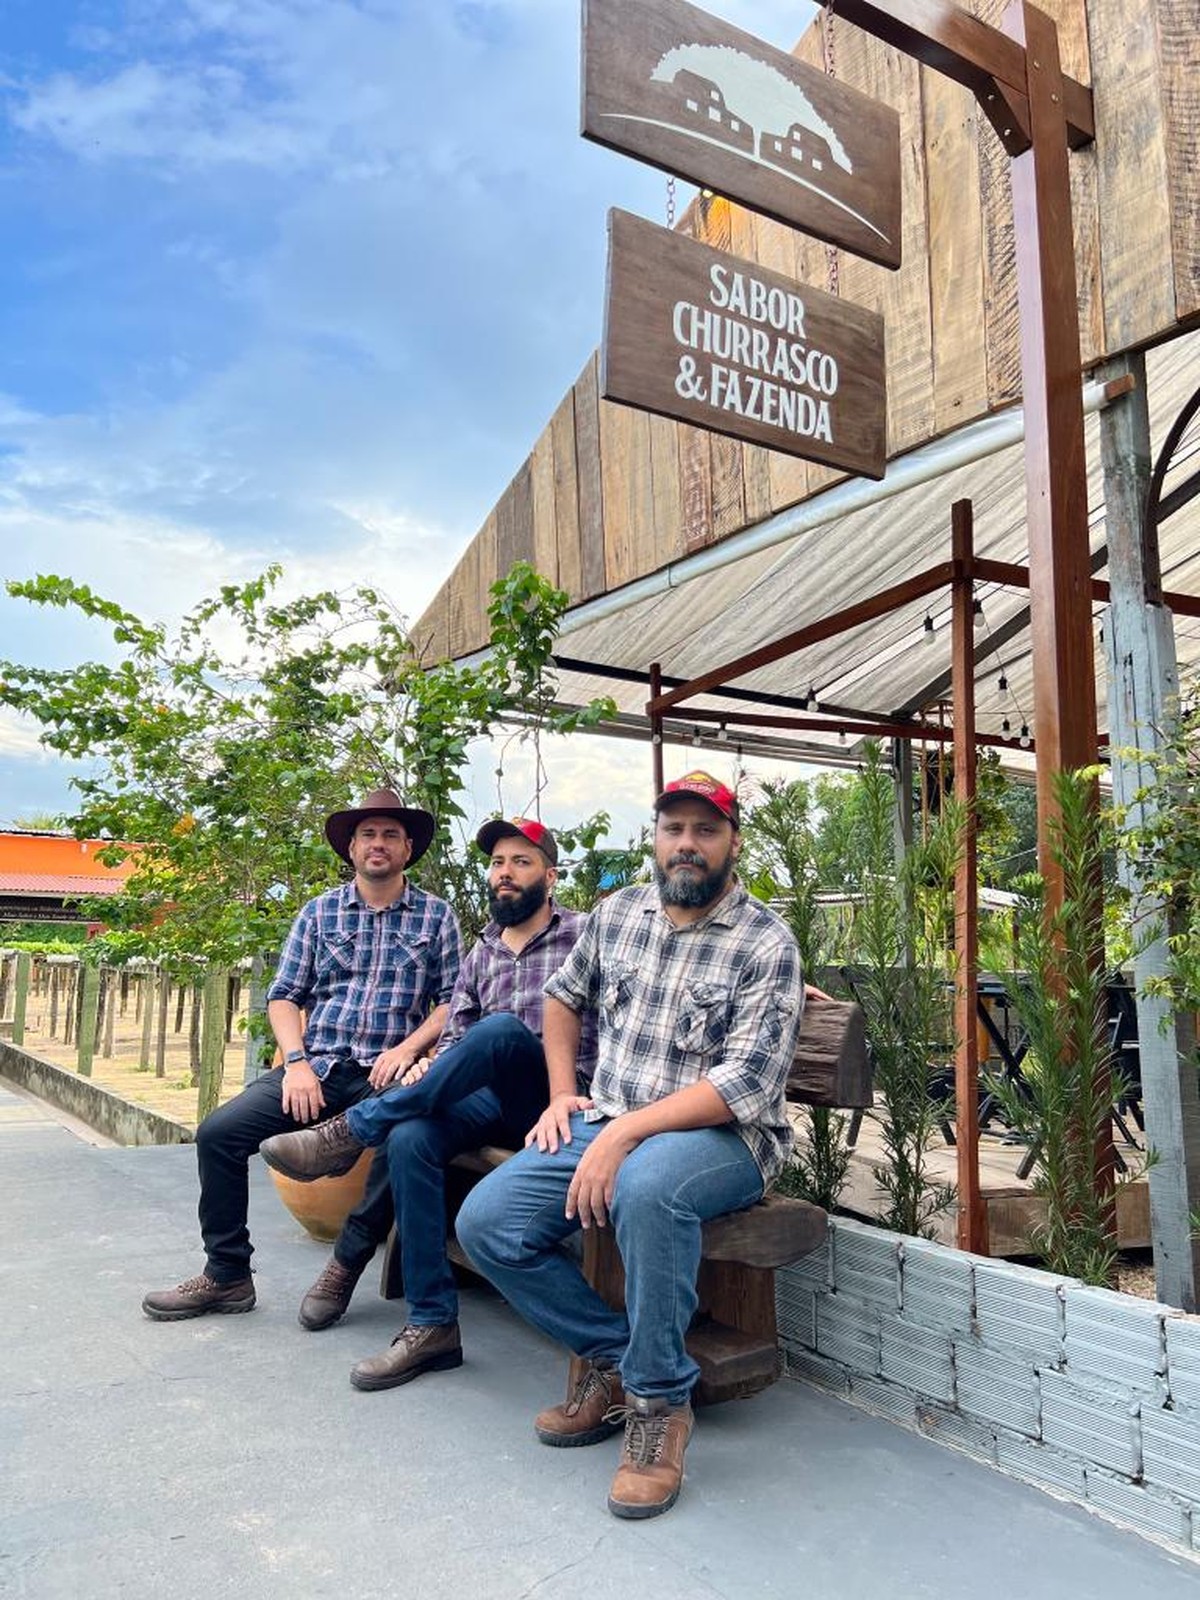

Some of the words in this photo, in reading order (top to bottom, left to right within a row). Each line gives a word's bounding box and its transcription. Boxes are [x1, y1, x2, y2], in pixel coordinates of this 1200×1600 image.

[710, 264, 806, 338] SABOR
[672, 301, 838, 395] CHURRASCO
[710, 363, 833, 444] FAZENDA
